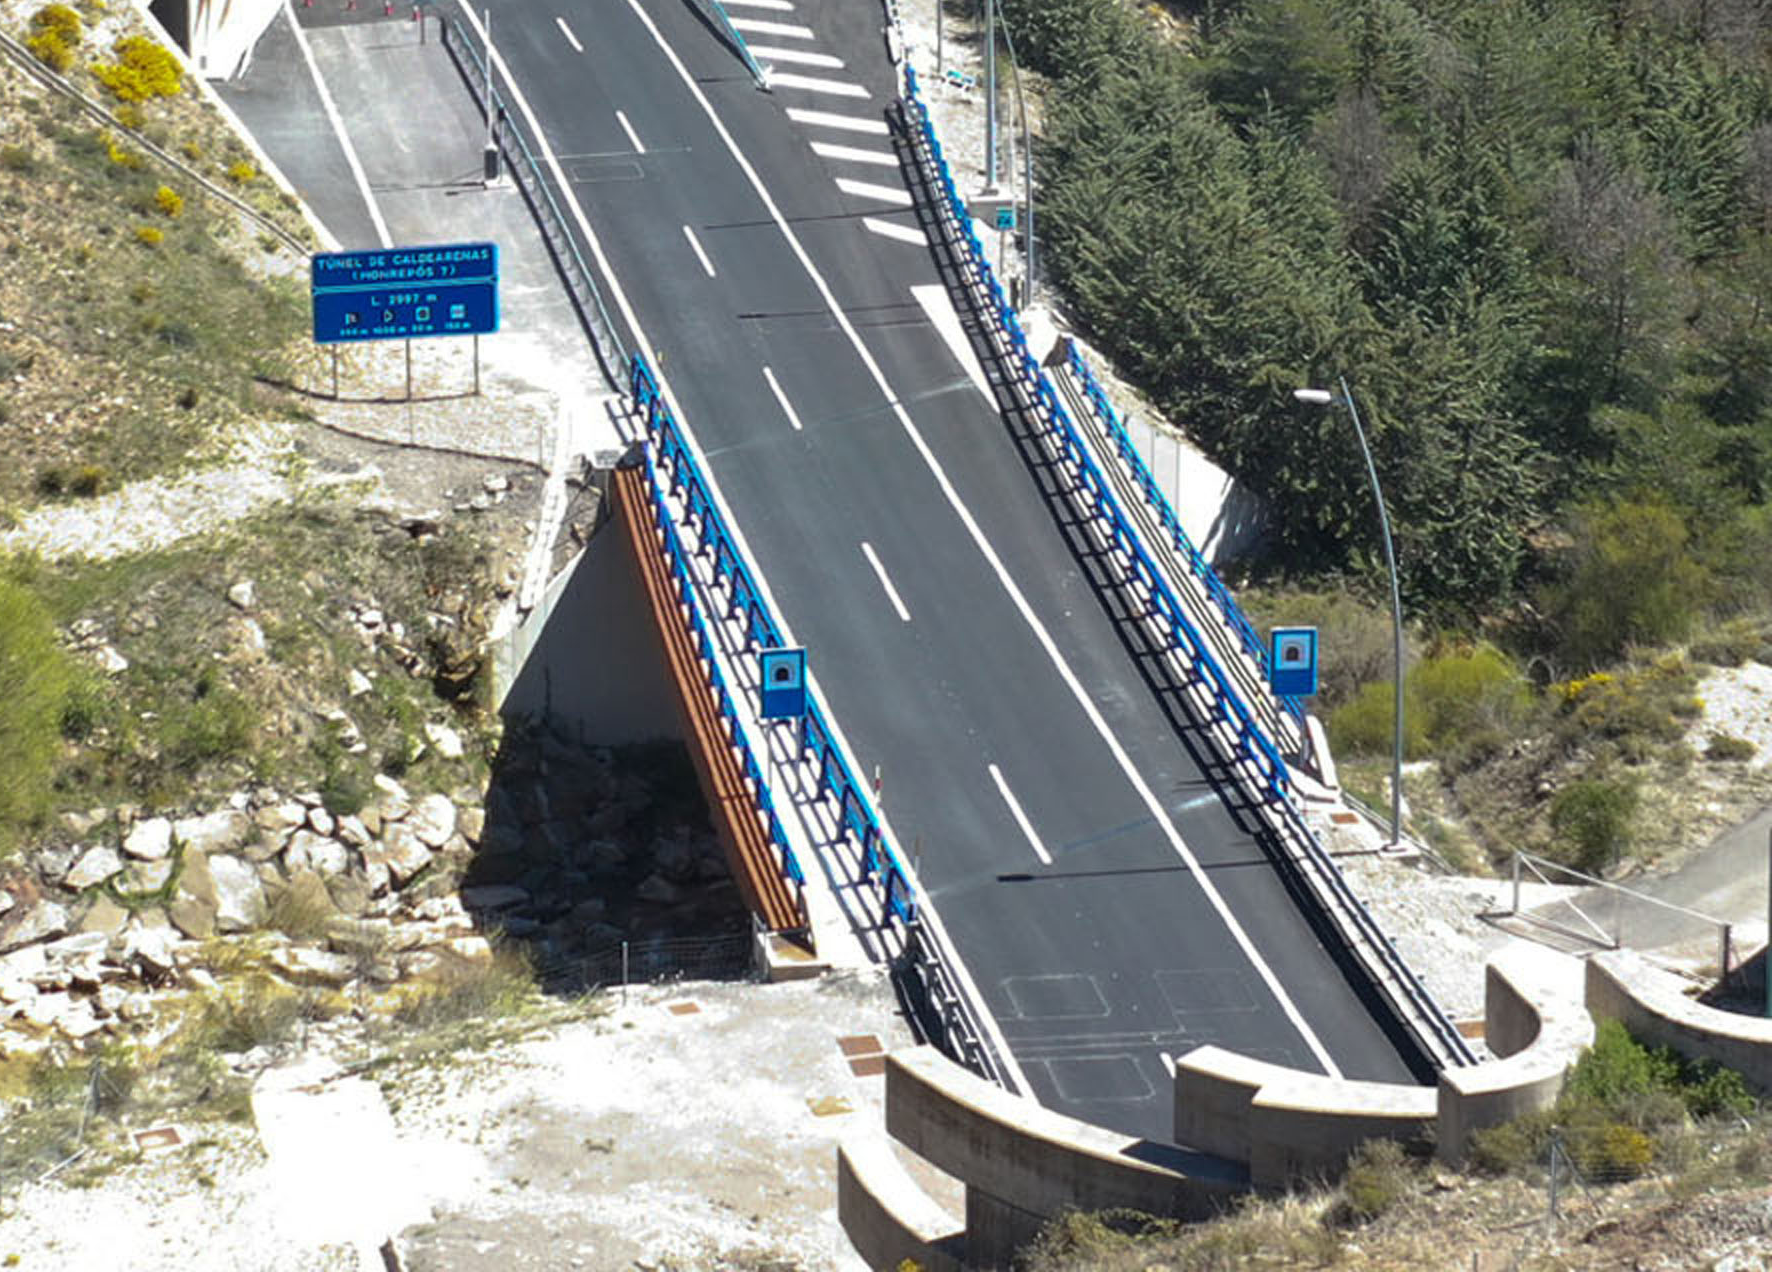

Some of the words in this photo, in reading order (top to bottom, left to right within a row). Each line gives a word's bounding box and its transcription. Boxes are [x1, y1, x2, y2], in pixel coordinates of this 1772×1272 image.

[317, 257, 362, 271] TÚNEL
[370, 256, 386, 268] DE
[371, 296, 381, 307] L
